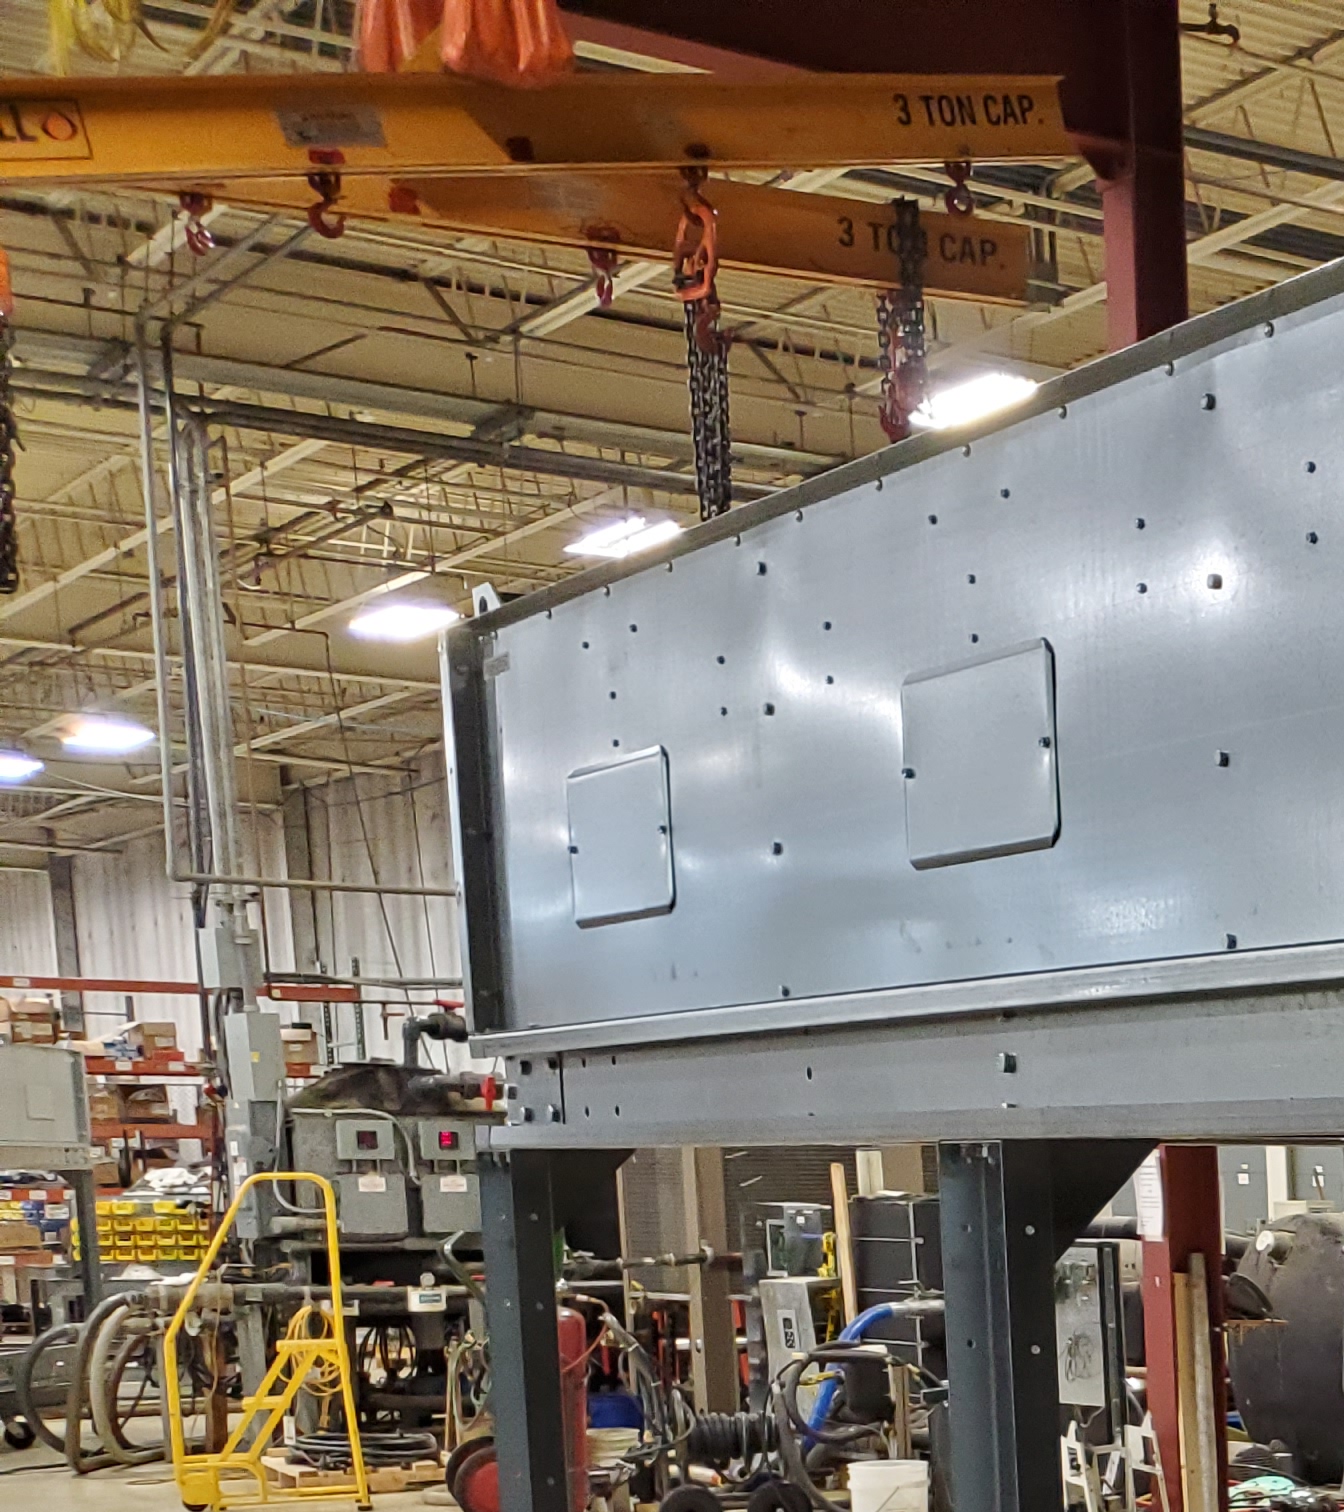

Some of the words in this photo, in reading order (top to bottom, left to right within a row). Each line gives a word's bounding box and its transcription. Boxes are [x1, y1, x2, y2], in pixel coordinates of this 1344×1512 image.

[893, 94, 911, 125] 3
[918, 95, 976, 126] TON
[982, 95, 1044, 125] CAP.
[837, 216, 855, 247] 3
